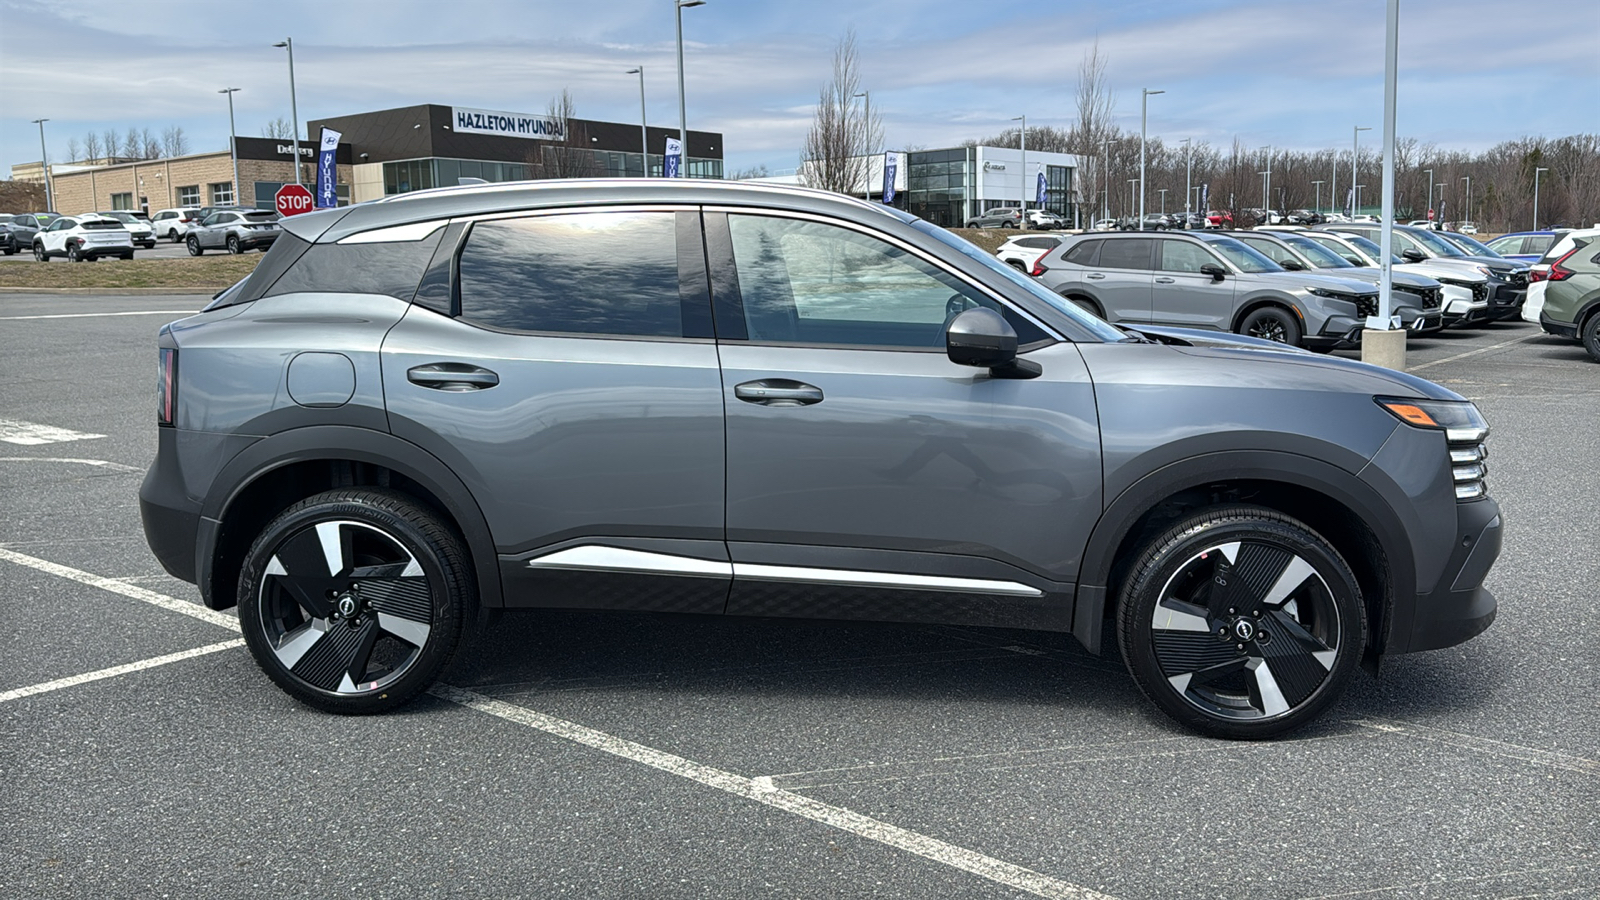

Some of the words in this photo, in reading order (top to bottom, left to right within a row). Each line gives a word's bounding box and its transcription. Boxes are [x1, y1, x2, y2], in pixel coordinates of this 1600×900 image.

[457, 112, 516, 132] HAZLETON
[517, 118, 564, 137] HYUNDAI
[277, 144, 314, 158] Deliery
[323, 153, 332, 206] HYUNDAI
[278, 195, 311, 210] STOP
